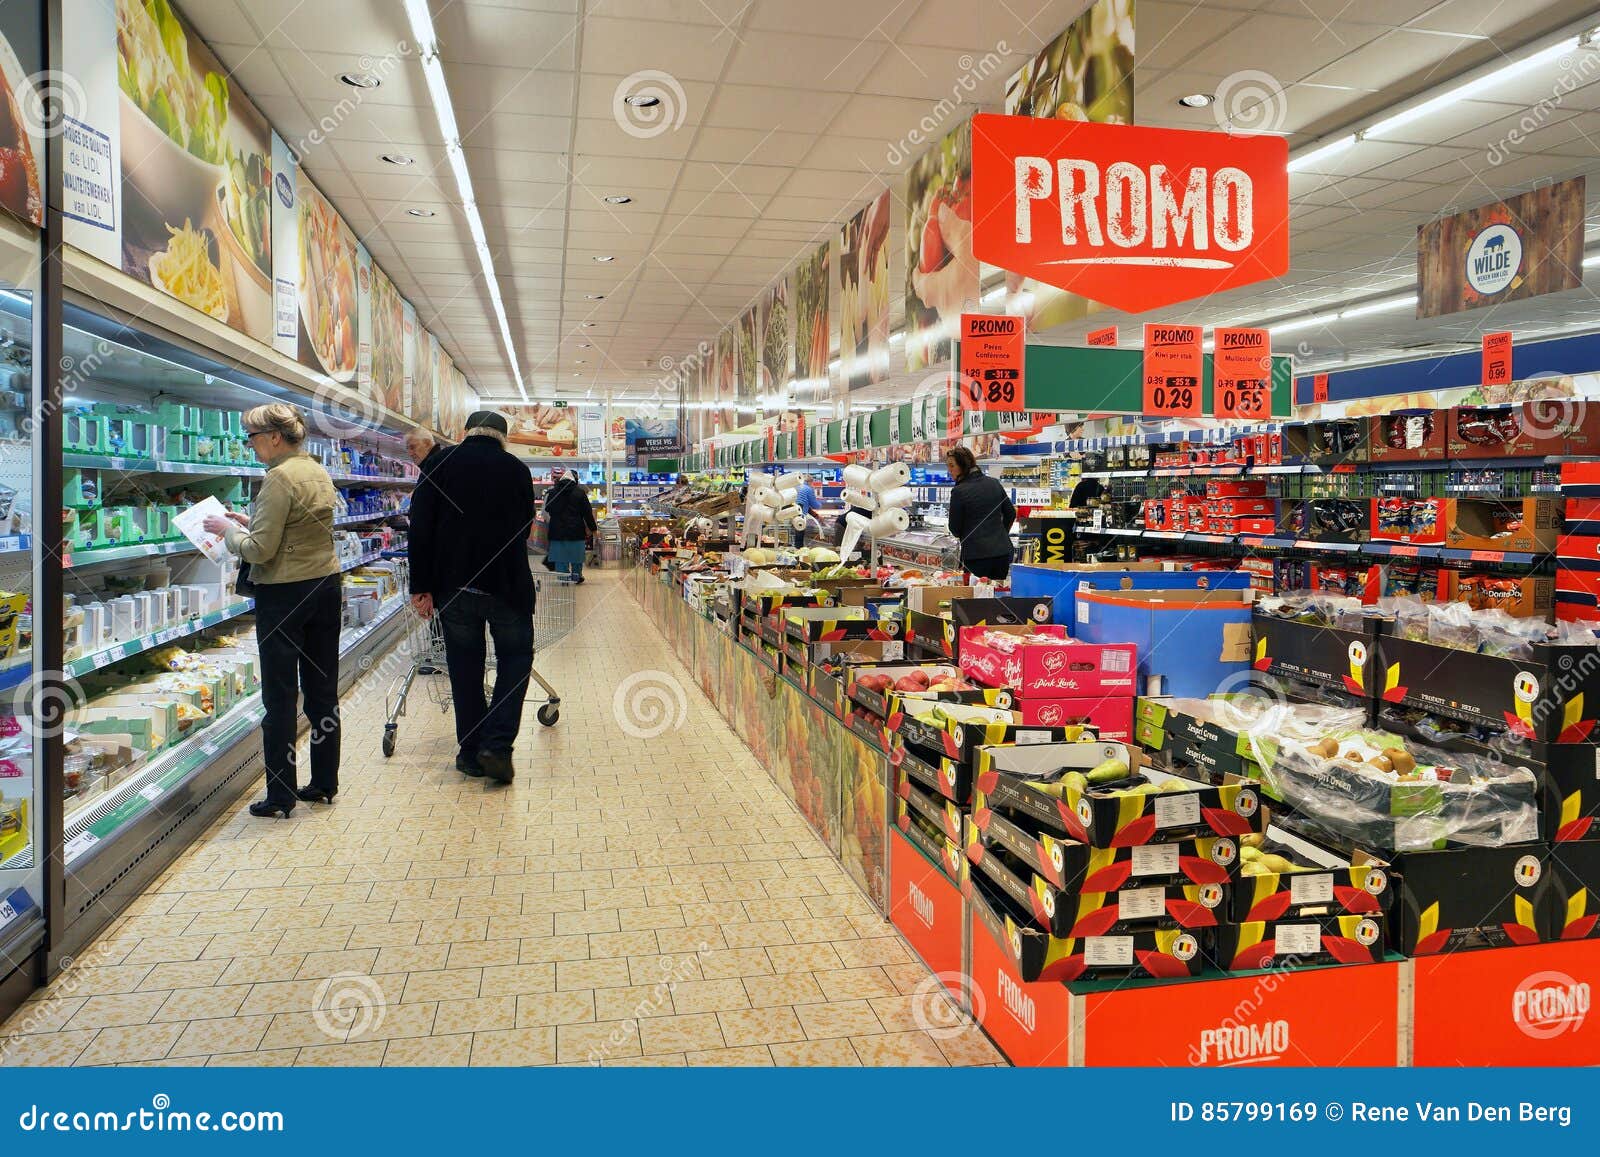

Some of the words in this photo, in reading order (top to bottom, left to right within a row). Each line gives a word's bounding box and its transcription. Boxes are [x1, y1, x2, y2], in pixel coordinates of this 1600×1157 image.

[82, 153, 101, 175] LIDL
[87, 203, 102, 219] LIDL
[1014, 155, 1253, 252] PROMO
[1474, 250, 1511, 275] WILDE
[971, 320, 1014, 333] PROMO
[1154, 330, 1194, 343] PROMO
[1224, 333, 1262, 345] PROMO
[1488, 367, 1506, 380] 0.99
[970, 380, 1015, 403] 0.89
[1153, 387, 1193, 410] 0.29
[1027, 678, 1055, 689] Pink
[1057, 677, 1080, 690] Lady
[1187, 723, 1204, 736] Zespri
[1203, 729, 1218, 742] Green
[1185, 747, 1201, 760] Zespri
[1200, 752, 1216, 766] Green
[909, 881, 935, 926] PROMO
[997, 968, 1036, 1031] PROMO
[1513, 982, 1591, 1023] PROMO
[1200, 1019, 1289, 1063] PROMO
